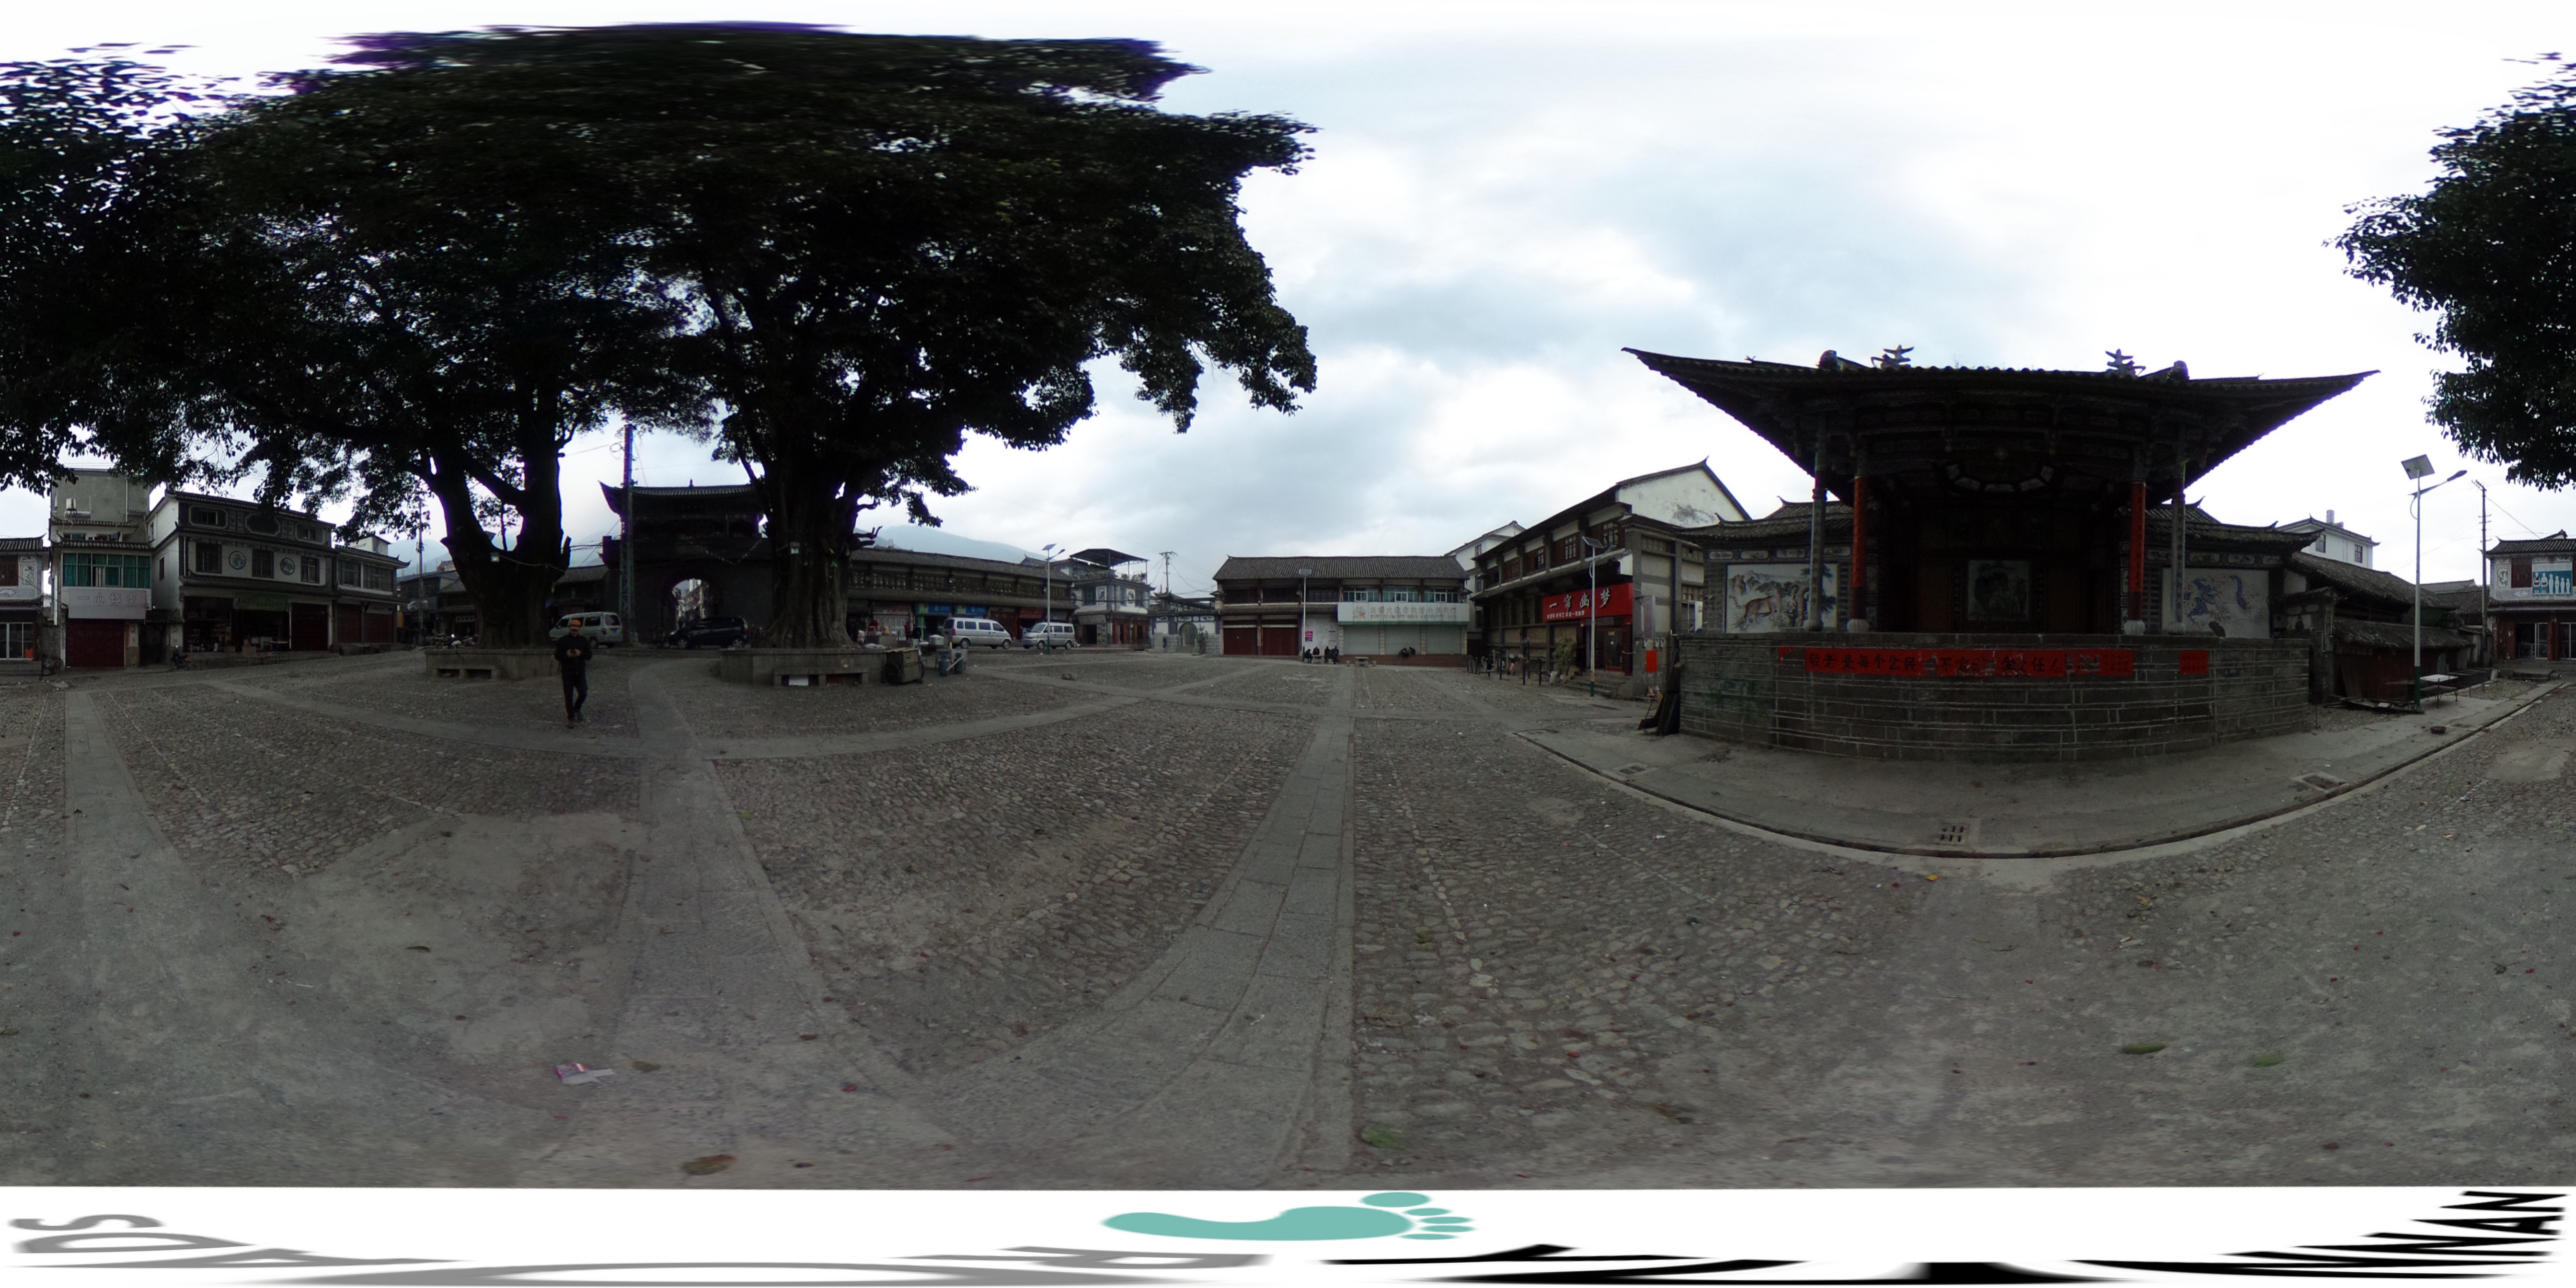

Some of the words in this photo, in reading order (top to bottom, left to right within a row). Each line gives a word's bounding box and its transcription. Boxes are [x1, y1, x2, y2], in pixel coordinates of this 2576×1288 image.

[78, 592, 136, 607] 一心烧卤
[1549, 588, 1610, 612] 一帘幽梦
